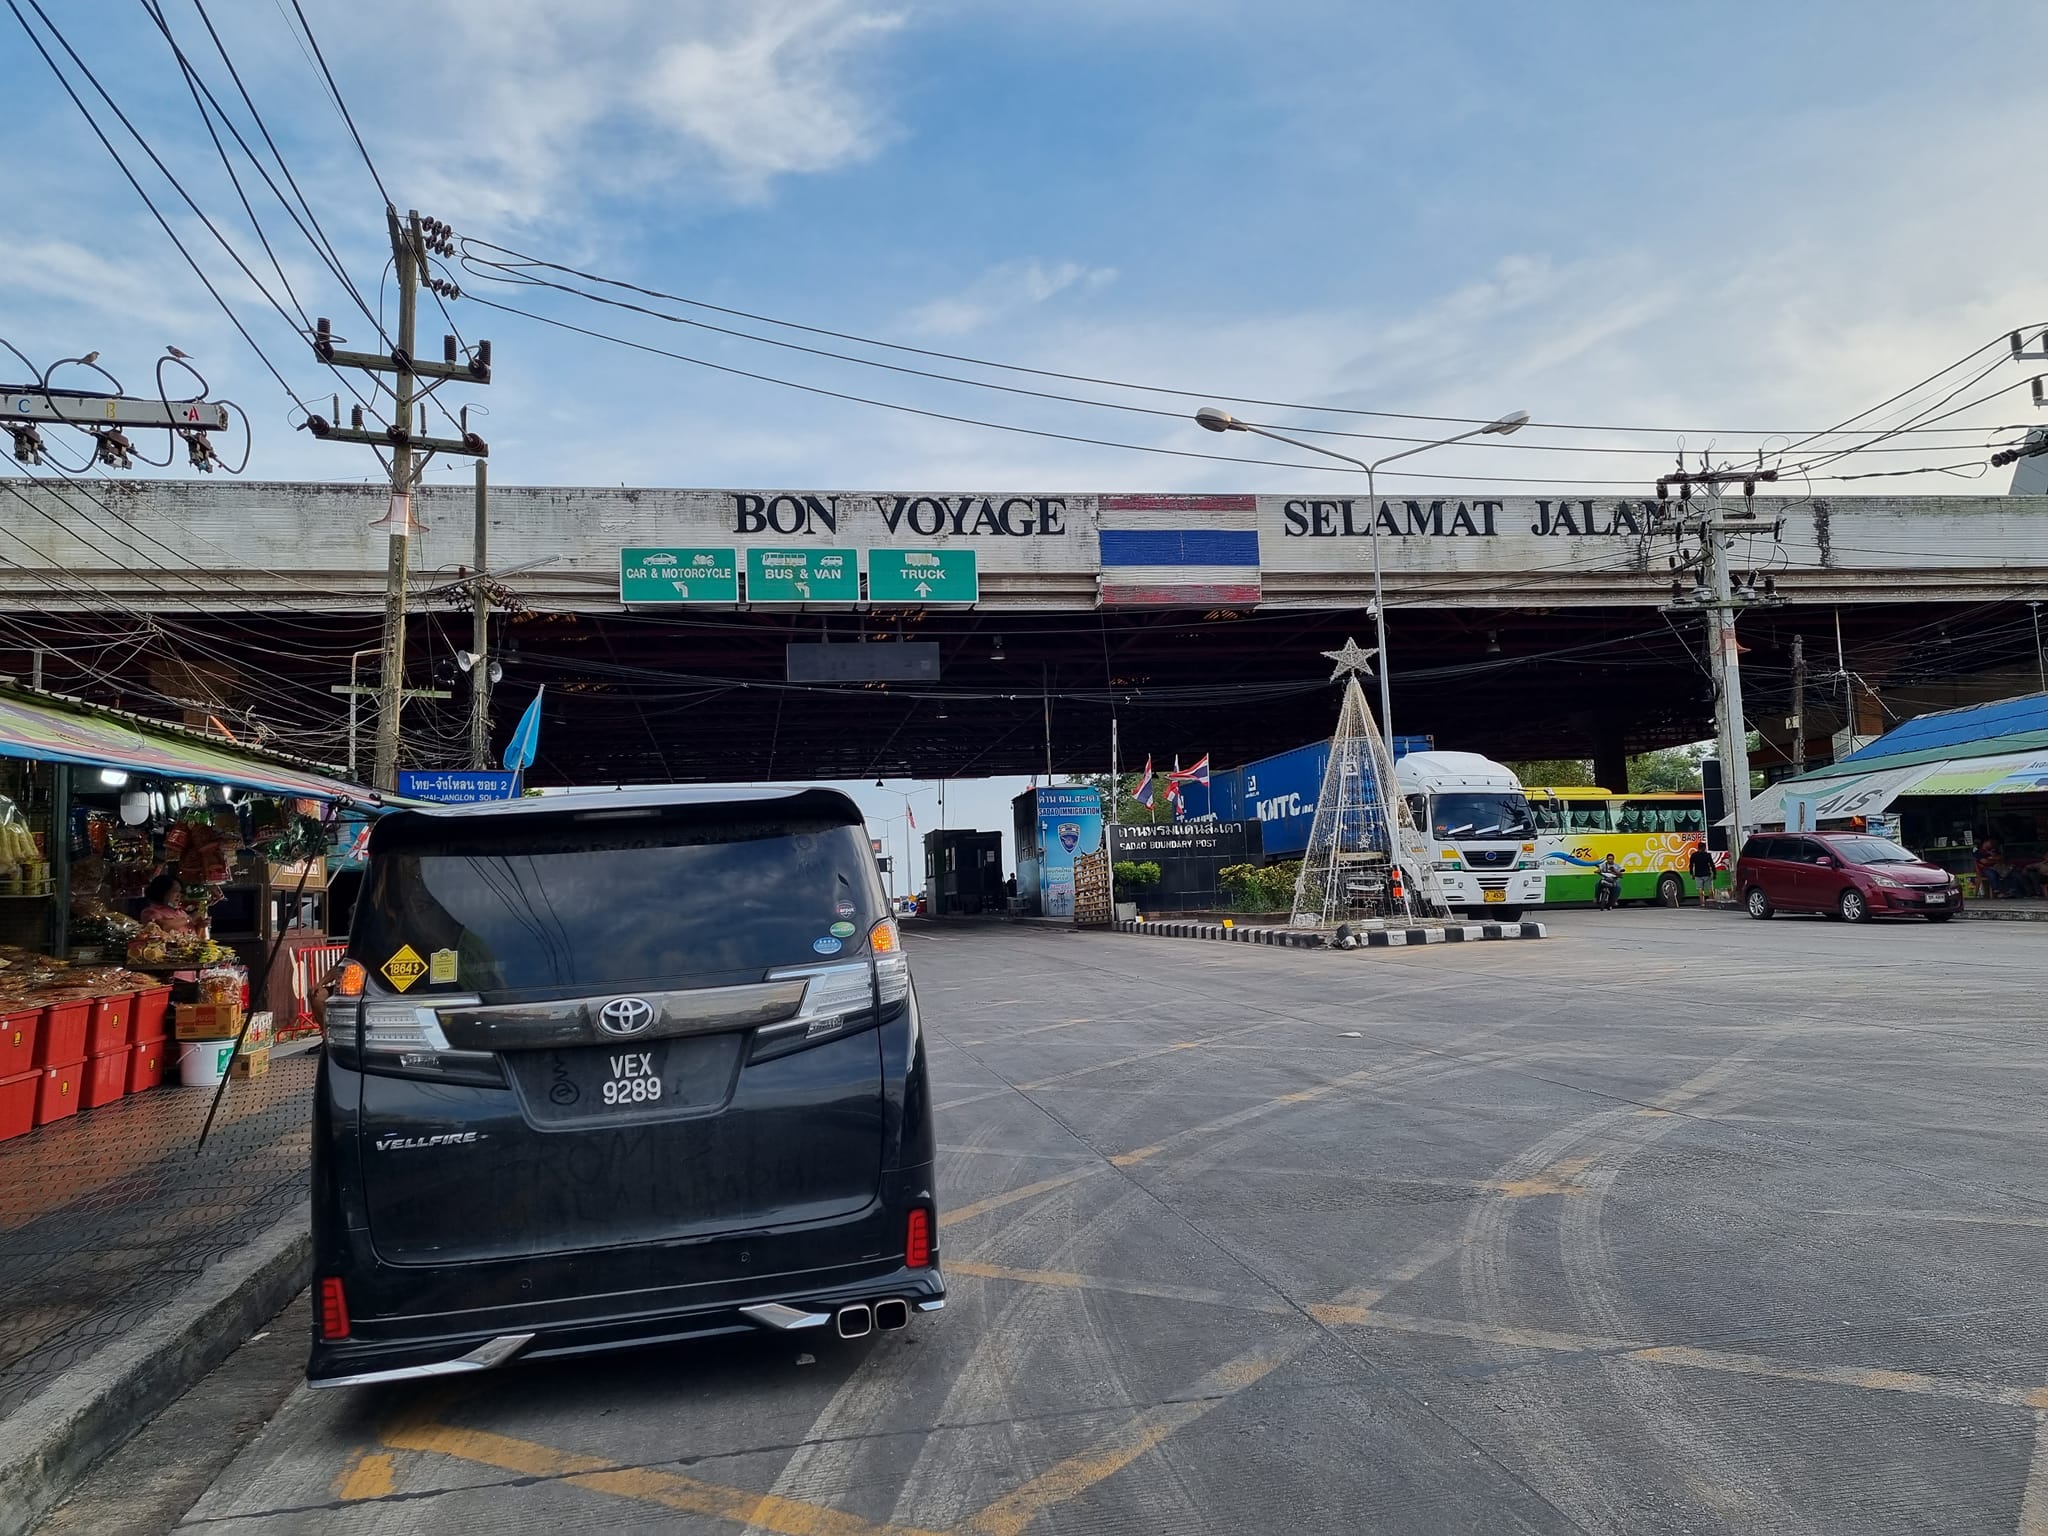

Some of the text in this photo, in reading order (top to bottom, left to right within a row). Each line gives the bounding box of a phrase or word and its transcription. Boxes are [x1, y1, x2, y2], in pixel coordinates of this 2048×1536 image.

[18, 400, 31, 413] C
[106, 402, 115, 418] B
[188, 406, 199, 421] A
[732, 494, 1067, 537] BON VOYAGE
[1283, 499, 1504, 537] SELAMAT
[626, 567, 732, 579] CAR & MOTORCYCLE
[765, 568, 841, 580] BUS & VAN
[900, 568, 946, 580] TRUCK
[500, 781, 508, 790] 2
[1816, 789, 1883, 815] AIS
[1038, 806, 1101, 816] SADAO IMMIGRATION
[1119, 838, 1217, 851] SADAO BOUNDARY POST
[610, 1052, 652, 1079] VEX
[603, 1077, 661, 1105] 9289
[376, 1132, 478, 1151] VELLFIRE
